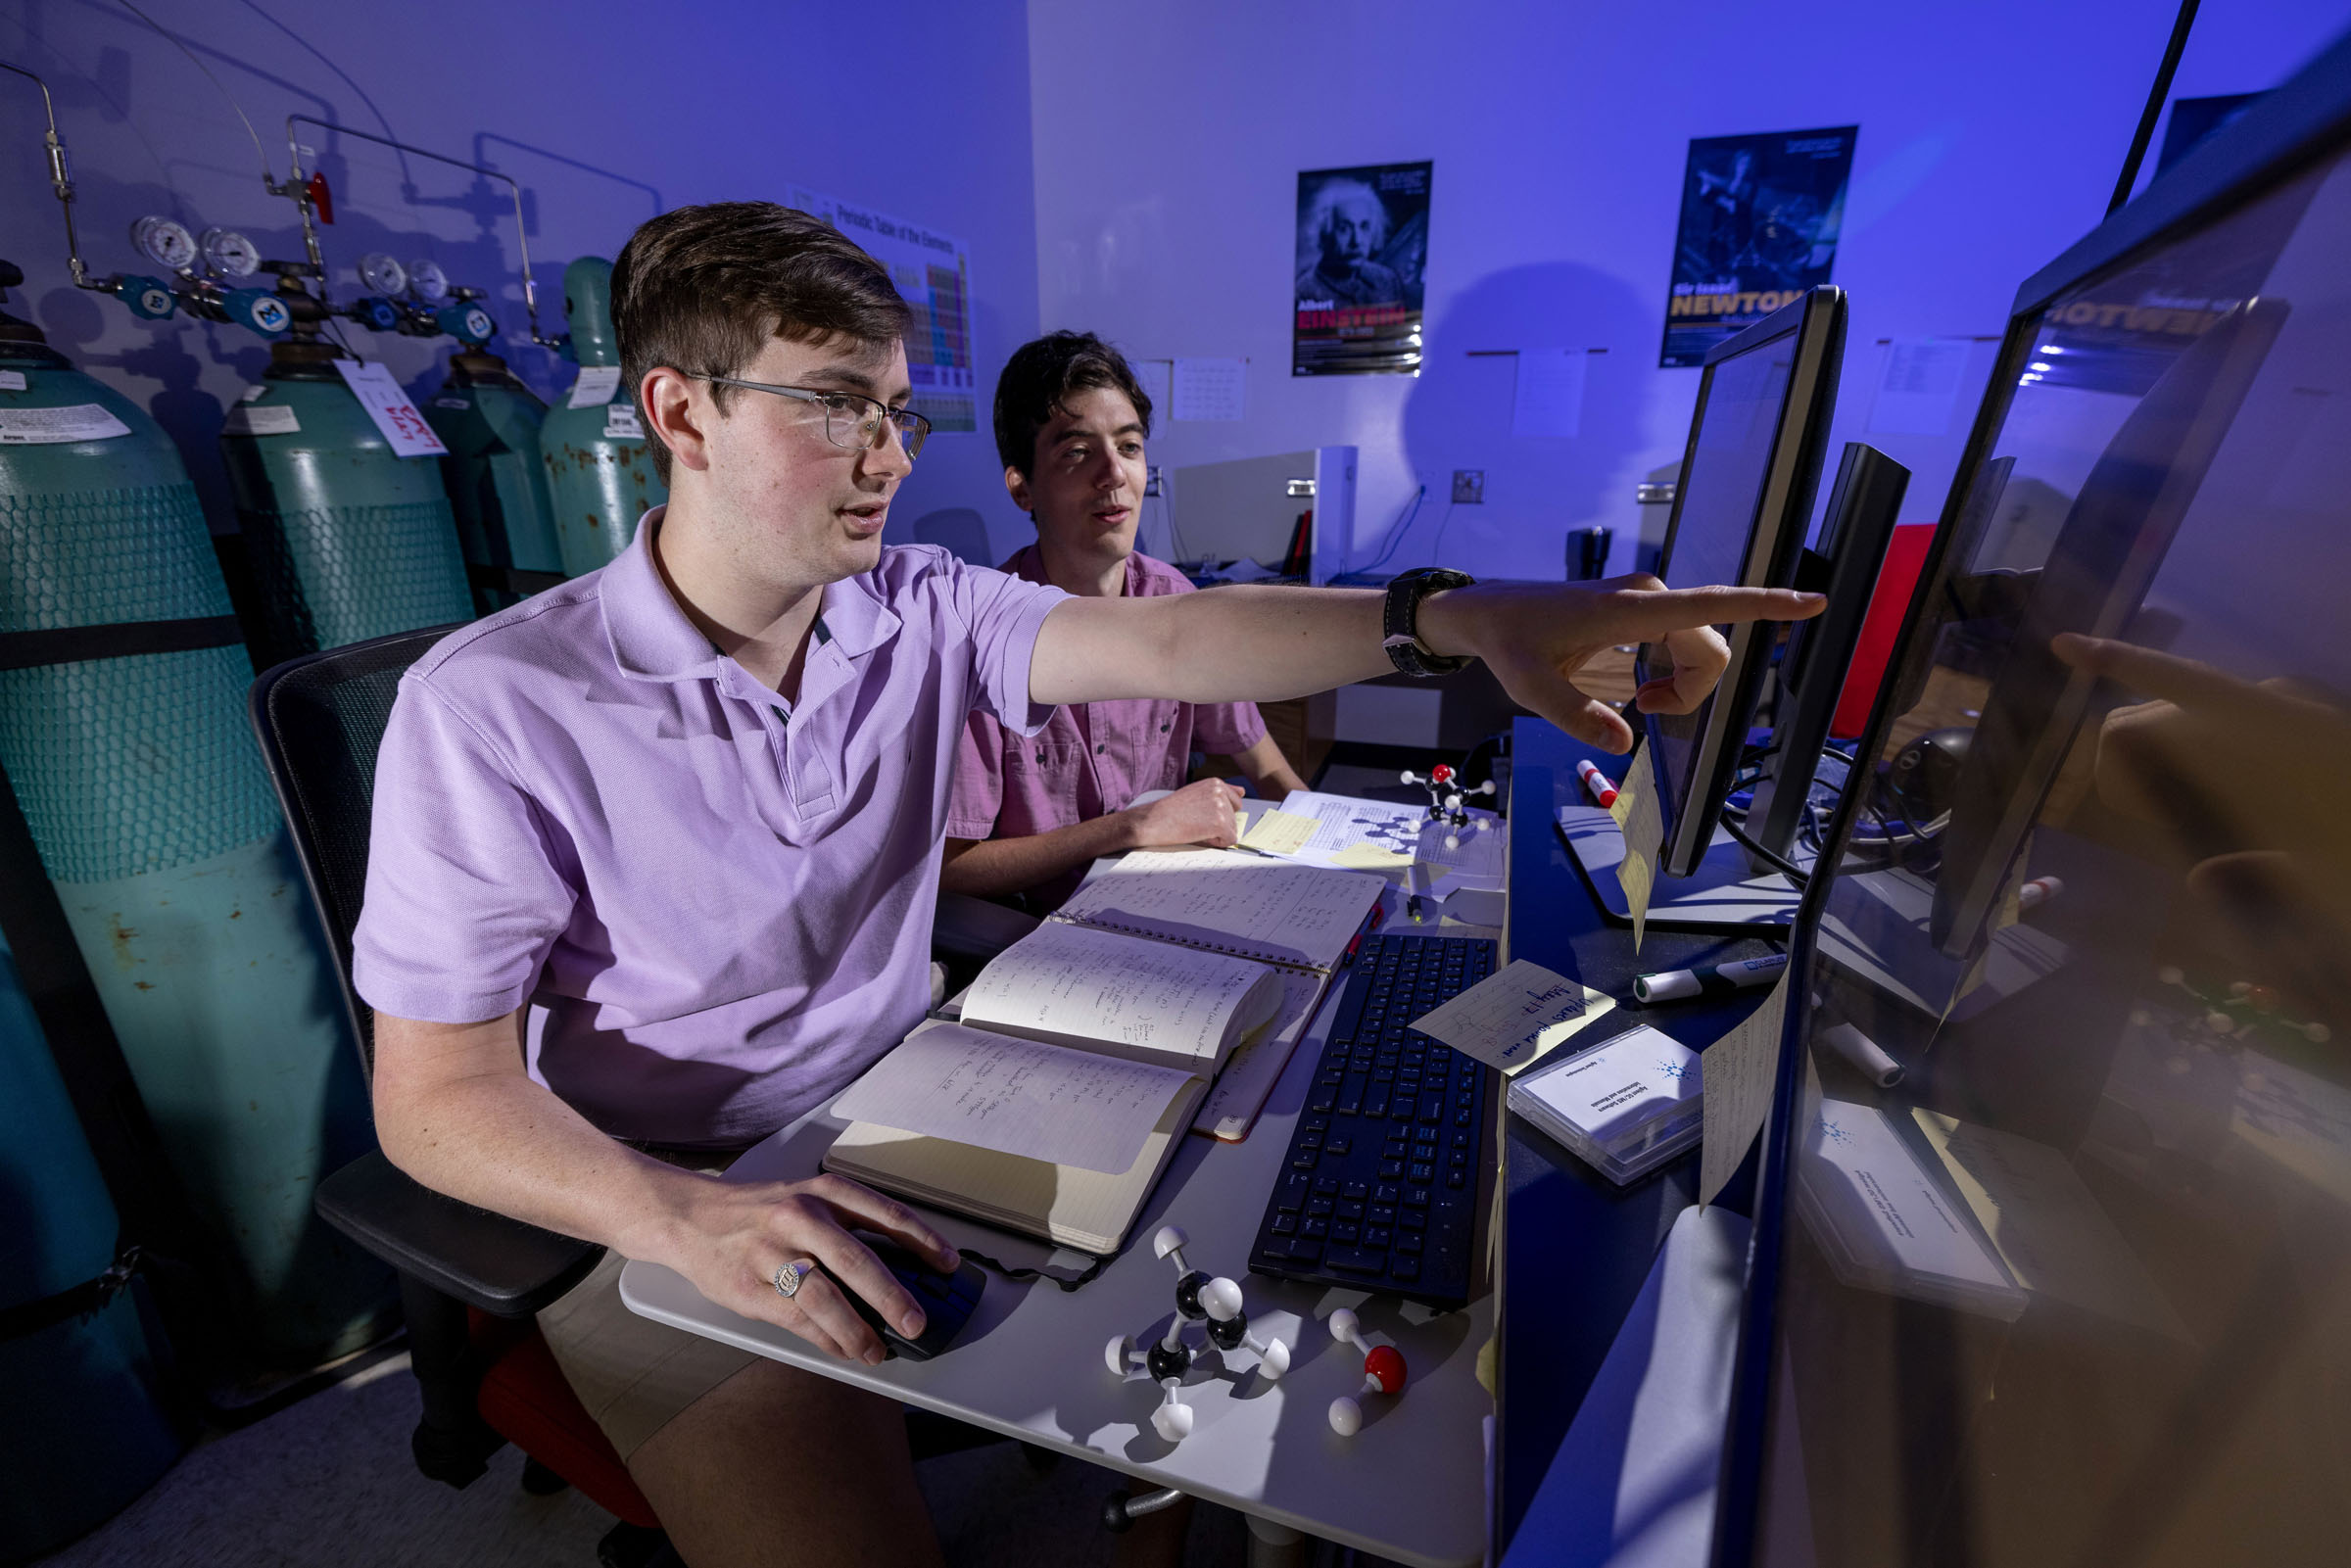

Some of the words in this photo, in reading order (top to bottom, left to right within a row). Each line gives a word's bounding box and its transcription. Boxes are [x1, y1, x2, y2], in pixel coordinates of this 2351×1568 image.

[837, 203, 874, 232] Periodic
[874, 215, 895, 238] Table
[898, 225, 906, 241] of
[908, 227, 920, 245] the
[922, 231, 954, 255] Elements
[1673, 282, 1695, 295] Sir
[1297, 299, 1334, 311] Albert
[1297, 307, 1407, 330] EINSTEIN
[1617, 1081, 1642, 1094] Information
[1632, 1086, 1648, 1096] Agilent
[1590, 1097, 1609, 1108] Manuals
[1617, 1092, 1634, 1103] GC/MS
[1598, 1100, 1619, 1113] Software
